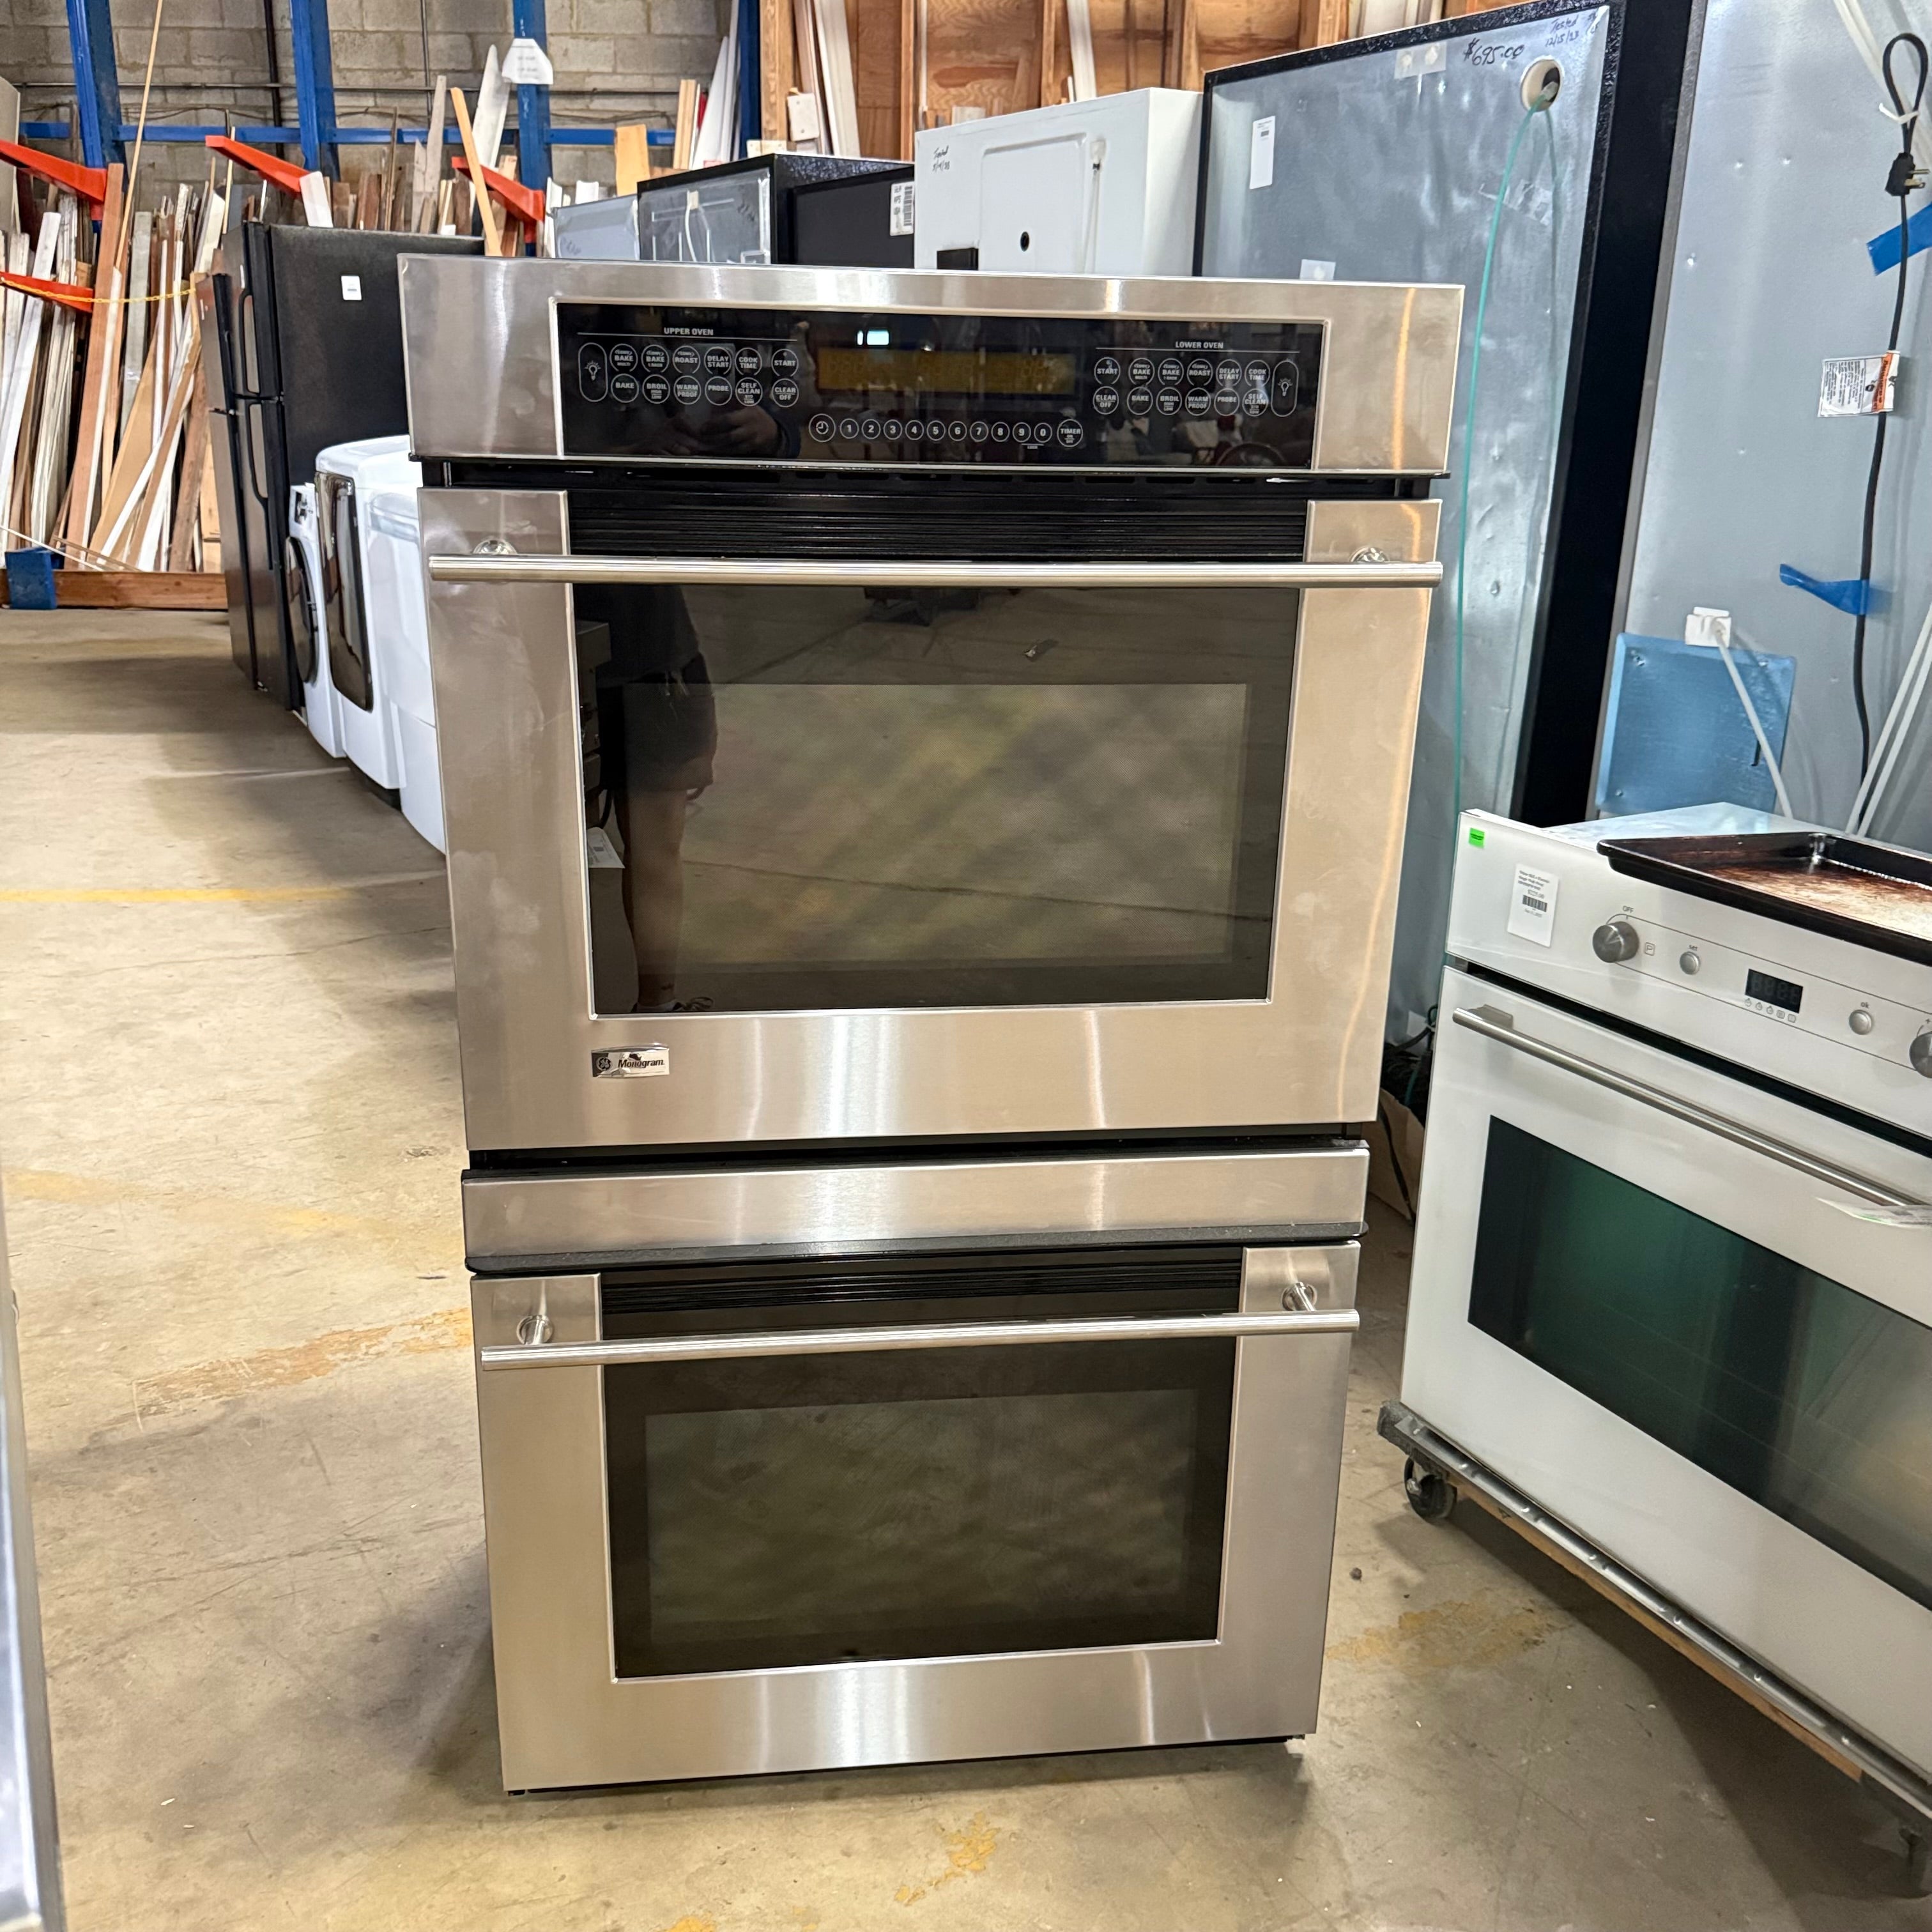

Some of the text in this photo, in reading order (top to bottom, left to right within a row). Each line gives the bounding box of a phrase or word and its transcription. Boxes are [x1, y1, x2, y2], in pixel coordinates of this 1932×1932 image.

[1550, 14, 1579, 34] Tested
[1463, 38, 1525, 66] $695.00
[847, 424, 852, 433] 1
[868, 425, 875, 433] 2
[889, 425, 896, 434] 3
[911, 425, 917, 434] 4
[933, 426, 939, 434] 5
[954, 427, 961, 435] 6
[976, 427, 982, 435] 7
[997, 427, 1004, 436] 8
[1039, 428, 1046, 436] 0
[618, 1059, 664, 1068] Monogram
